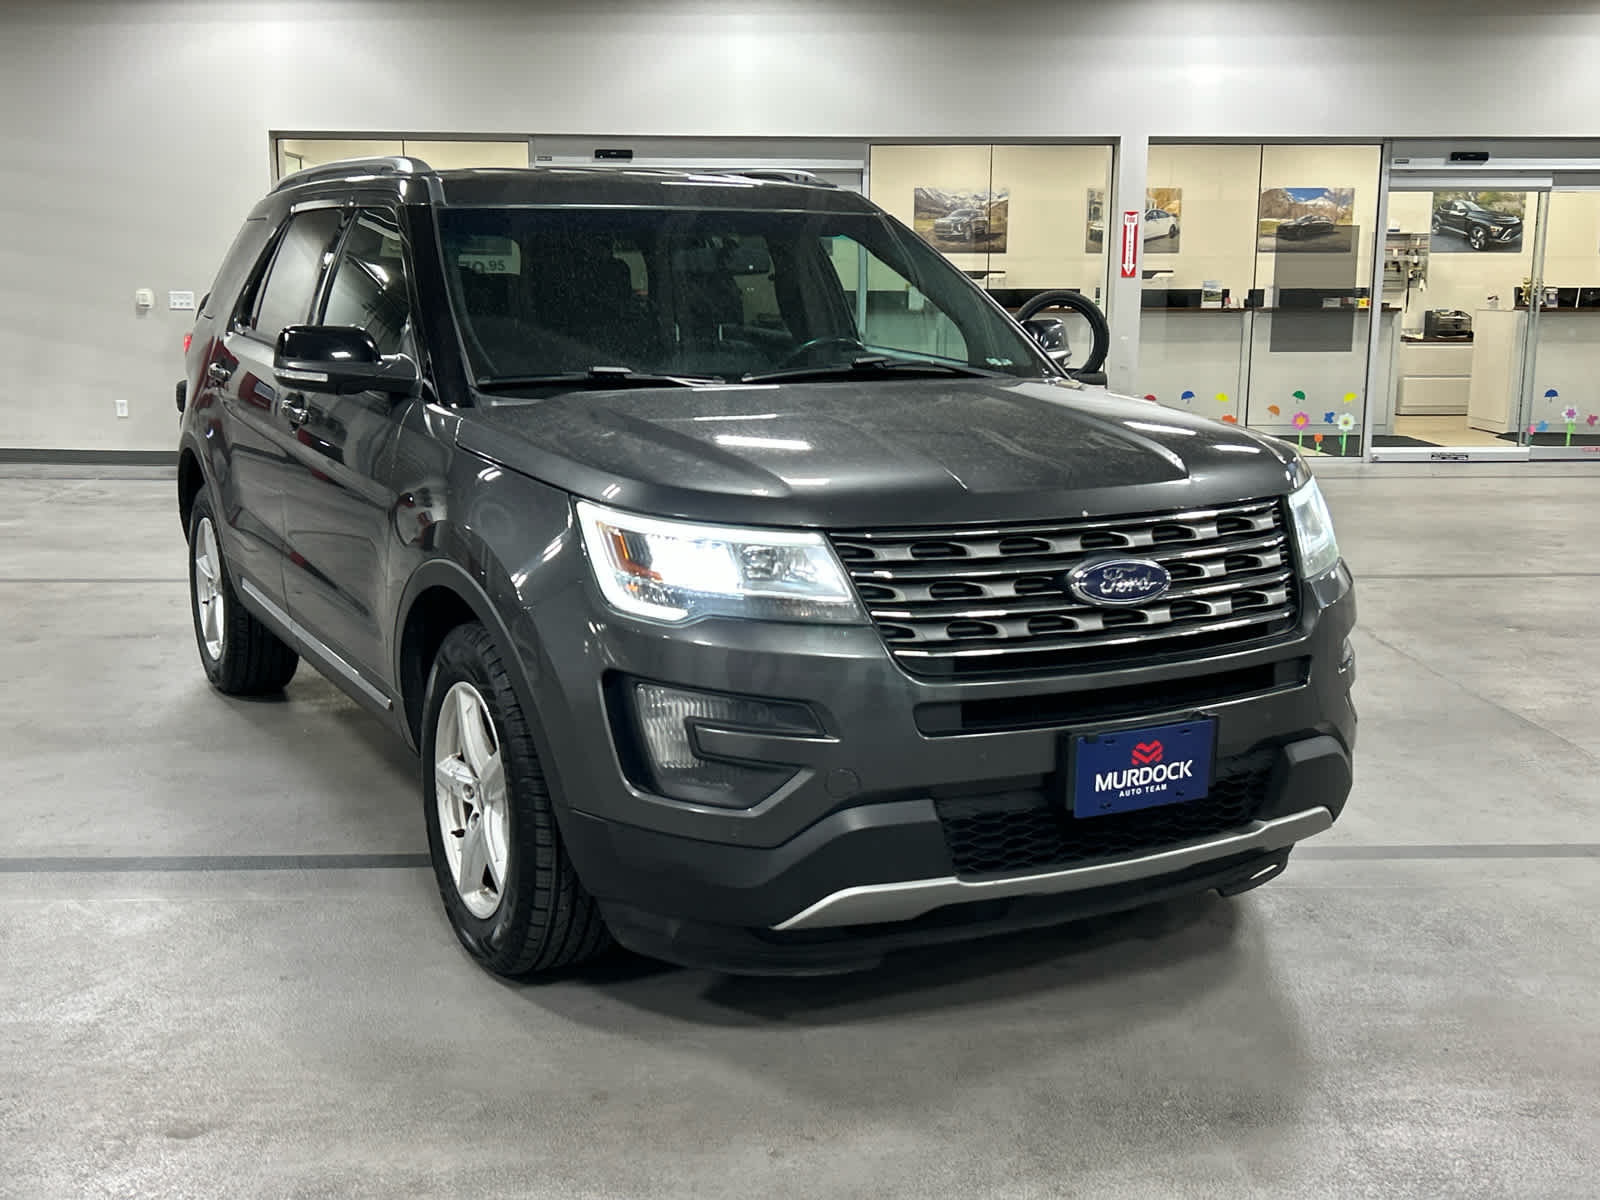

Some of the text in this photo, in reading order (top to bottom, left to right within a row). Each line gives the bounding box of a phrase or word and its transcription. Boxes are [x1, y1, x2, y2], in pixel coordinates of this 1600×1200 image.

[1100, 567, 1157, 594] Ford
[1095, 759, 1193, 792] MURDOCK
[1119, 783, 1167, 798] AUTO TEAM
